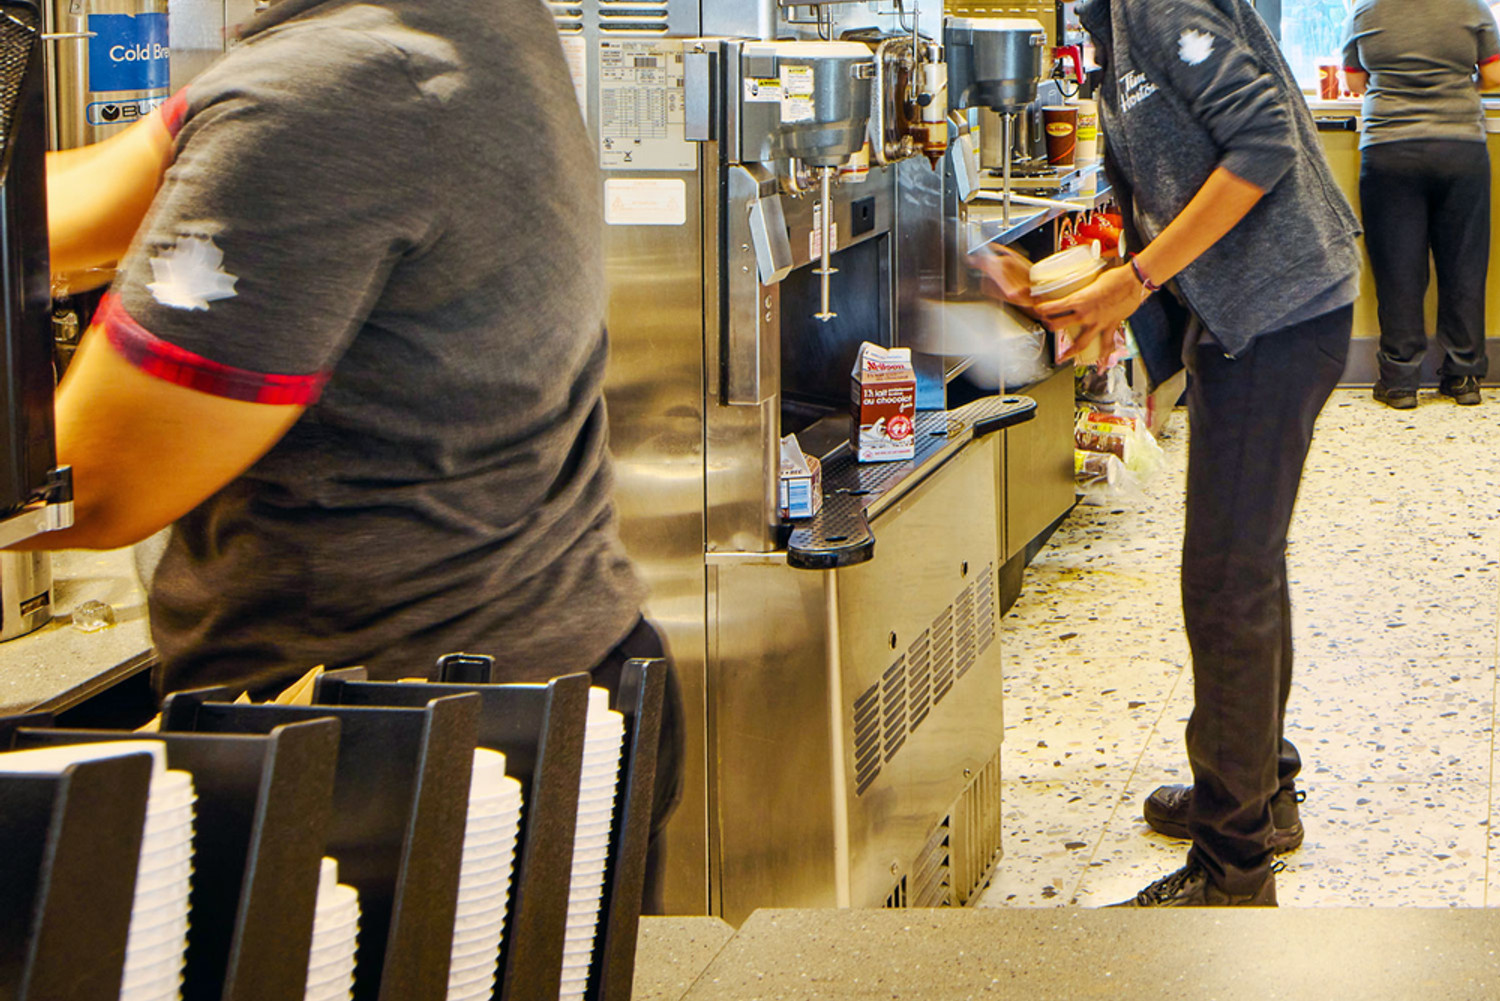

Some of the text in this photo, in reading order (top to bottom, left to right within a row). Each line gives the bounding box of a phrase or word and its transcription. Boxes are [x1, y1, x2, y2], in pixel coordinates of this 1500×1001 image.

[109, 43, 150, 62] Cold
[875, 388, 887, 397] lait
[863, 394, 912, 406] au chocolat
